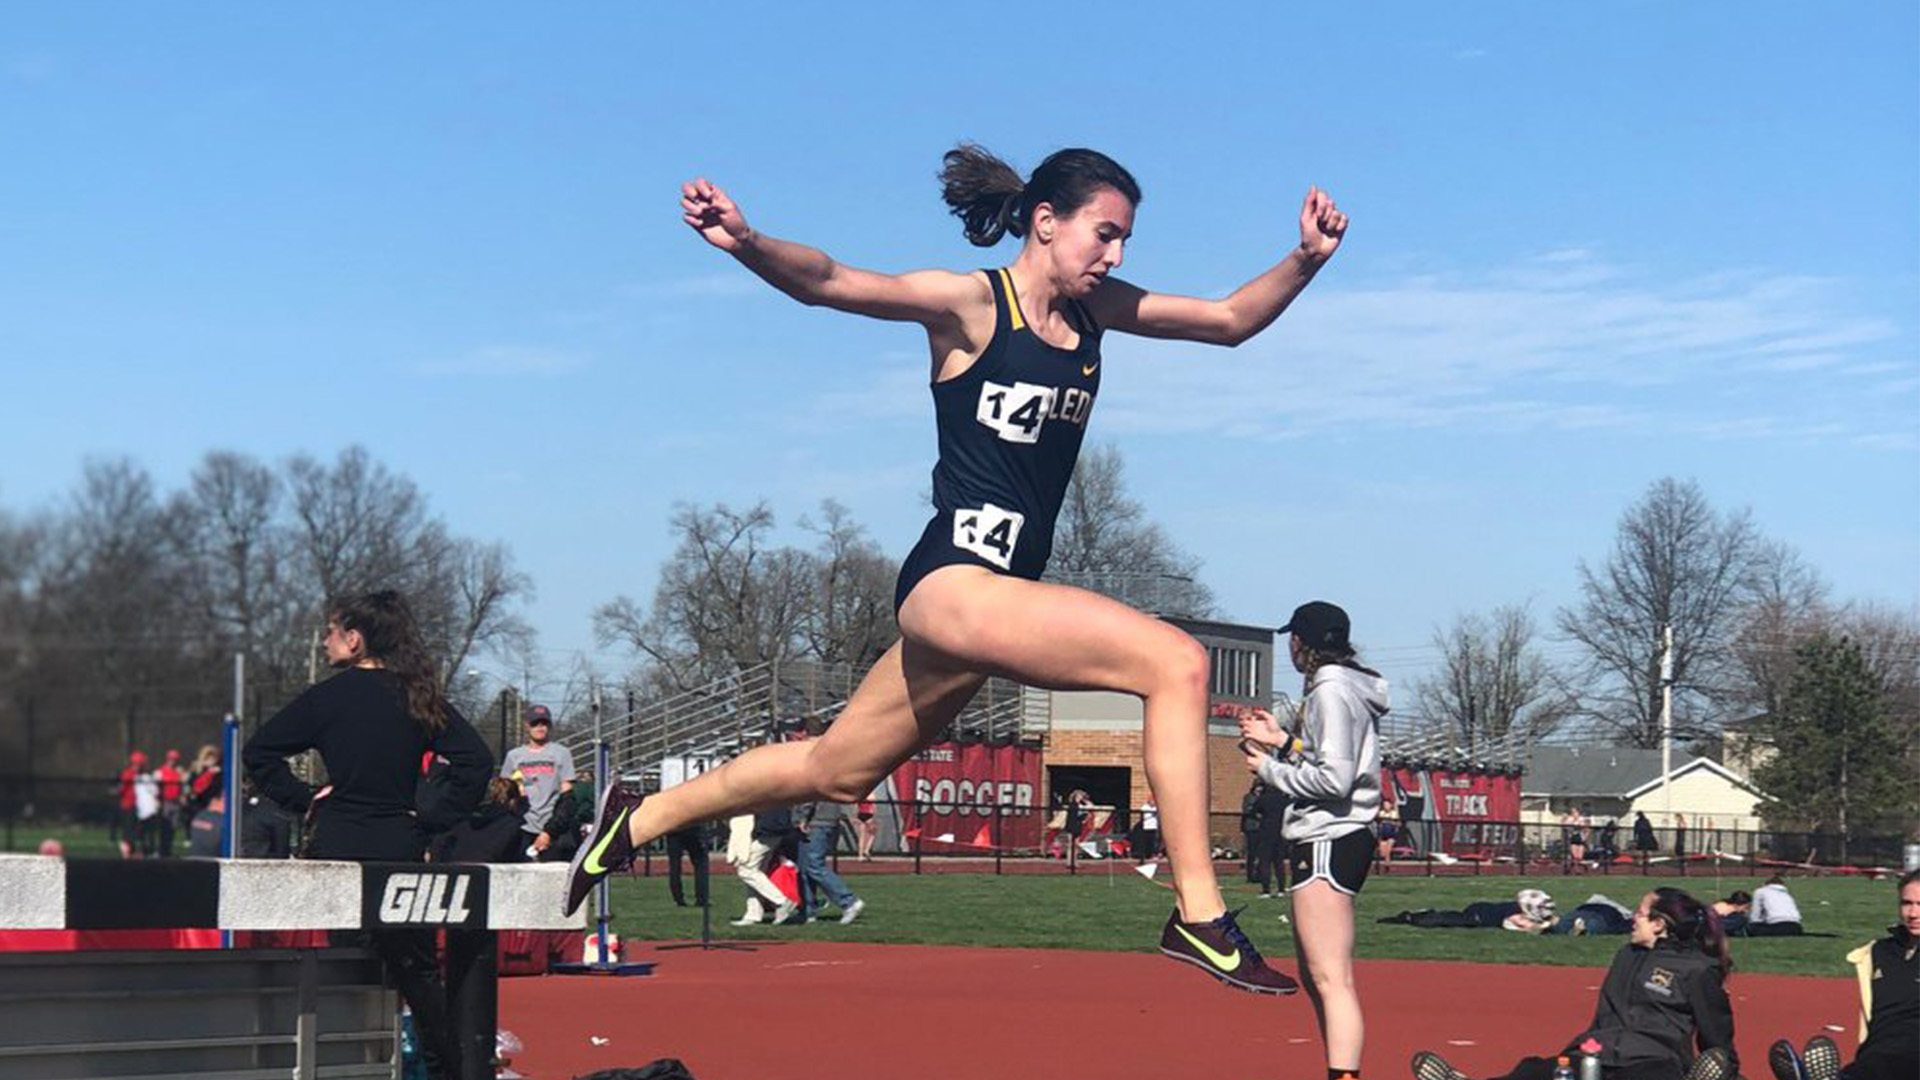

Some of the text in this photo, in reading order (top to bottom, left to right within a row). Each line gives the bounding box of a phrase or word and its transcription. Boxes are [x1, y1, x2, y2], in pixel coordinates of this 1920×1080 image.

[986, 391, 1044, 435] 14
[960, 516, 1013, 559] 14
[916, 778, 1034, 817] SOCCER
[1445, 794, 1489, 816] TRACK
[379, 872, 471, 924] GILL
